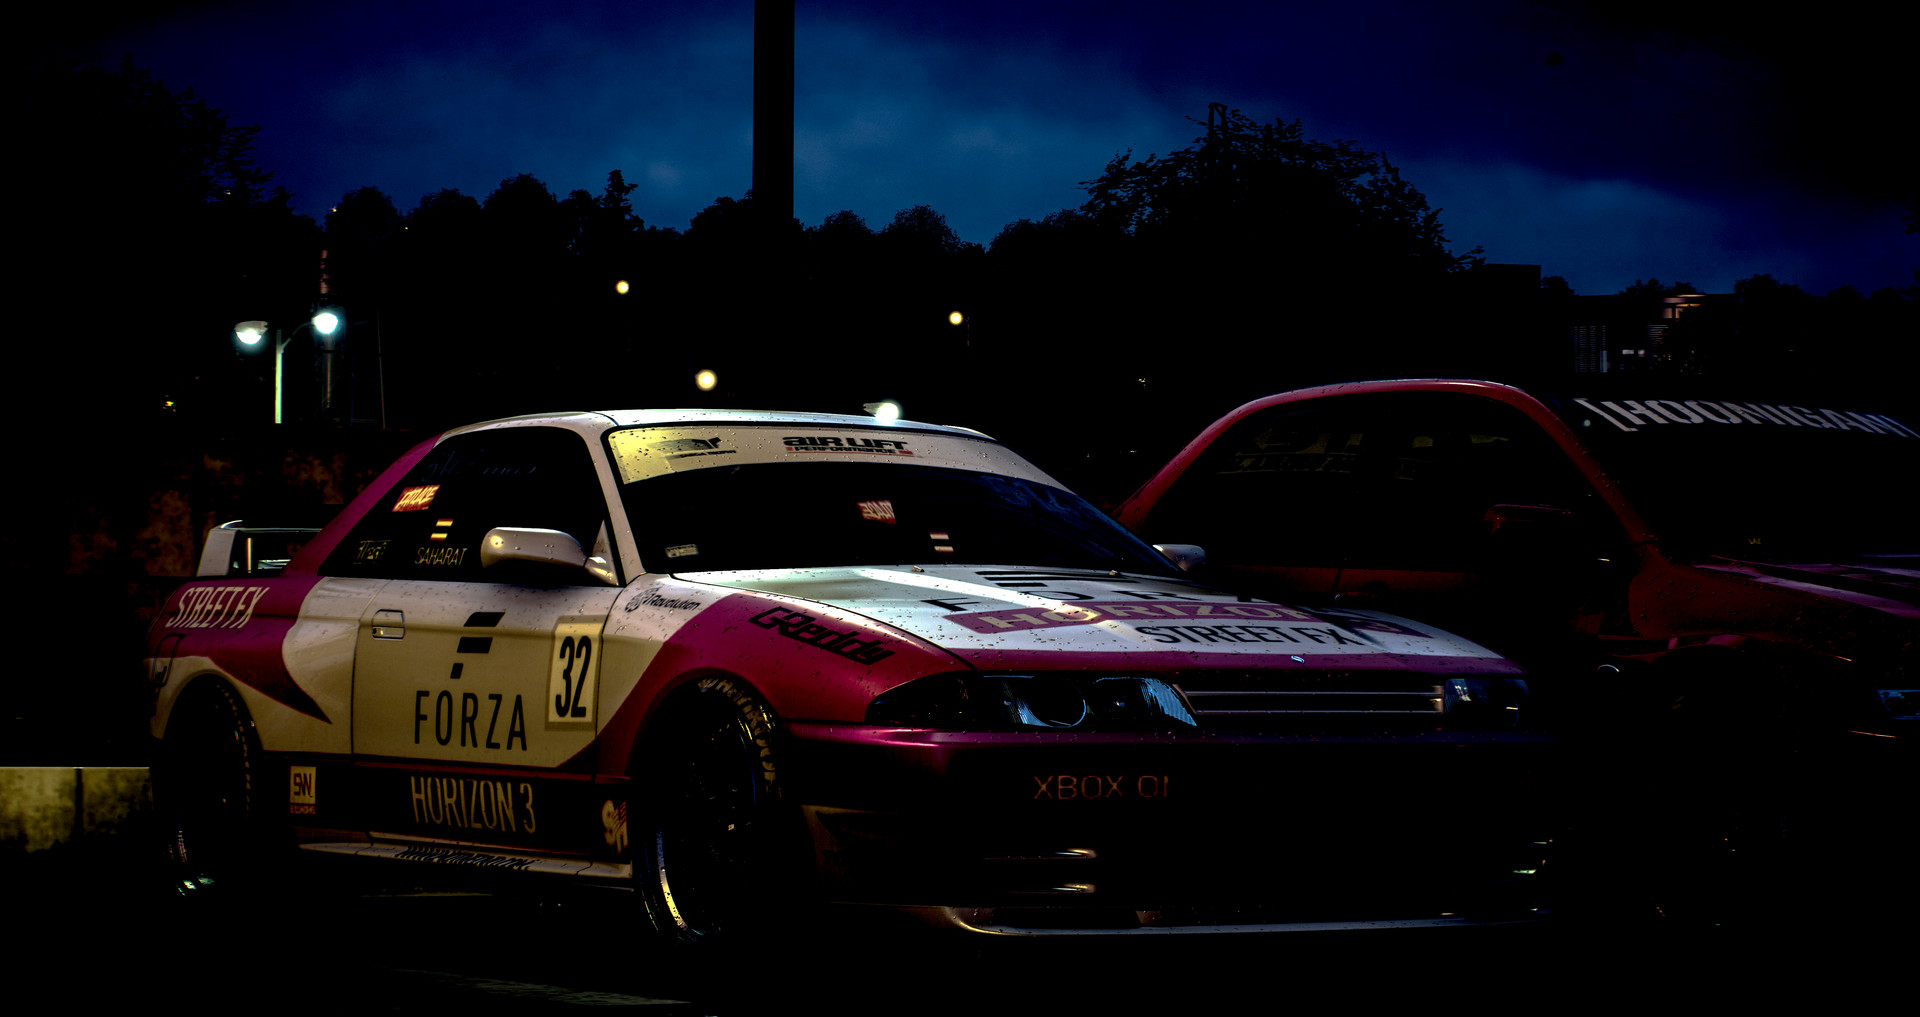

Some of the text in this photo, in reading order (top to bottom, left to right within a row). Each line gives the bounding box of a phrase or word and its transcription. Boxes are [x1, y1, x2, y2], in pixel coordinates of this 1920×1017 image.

[846, 437, 909, 450] LIFT
[414, 546, 469, 566] SAHARAT
[165, 586, 271, 629] STREET FX
[1135, 625, 1365, 646] STREET FX
[556, 635, 592, 717] 32
[414, 690, 527, 751] FORZA
[1033, 774, 1124, 800] XBOX
[410, 775, 517, 833] HORIZON
[519, 781, 537, 835] 3
